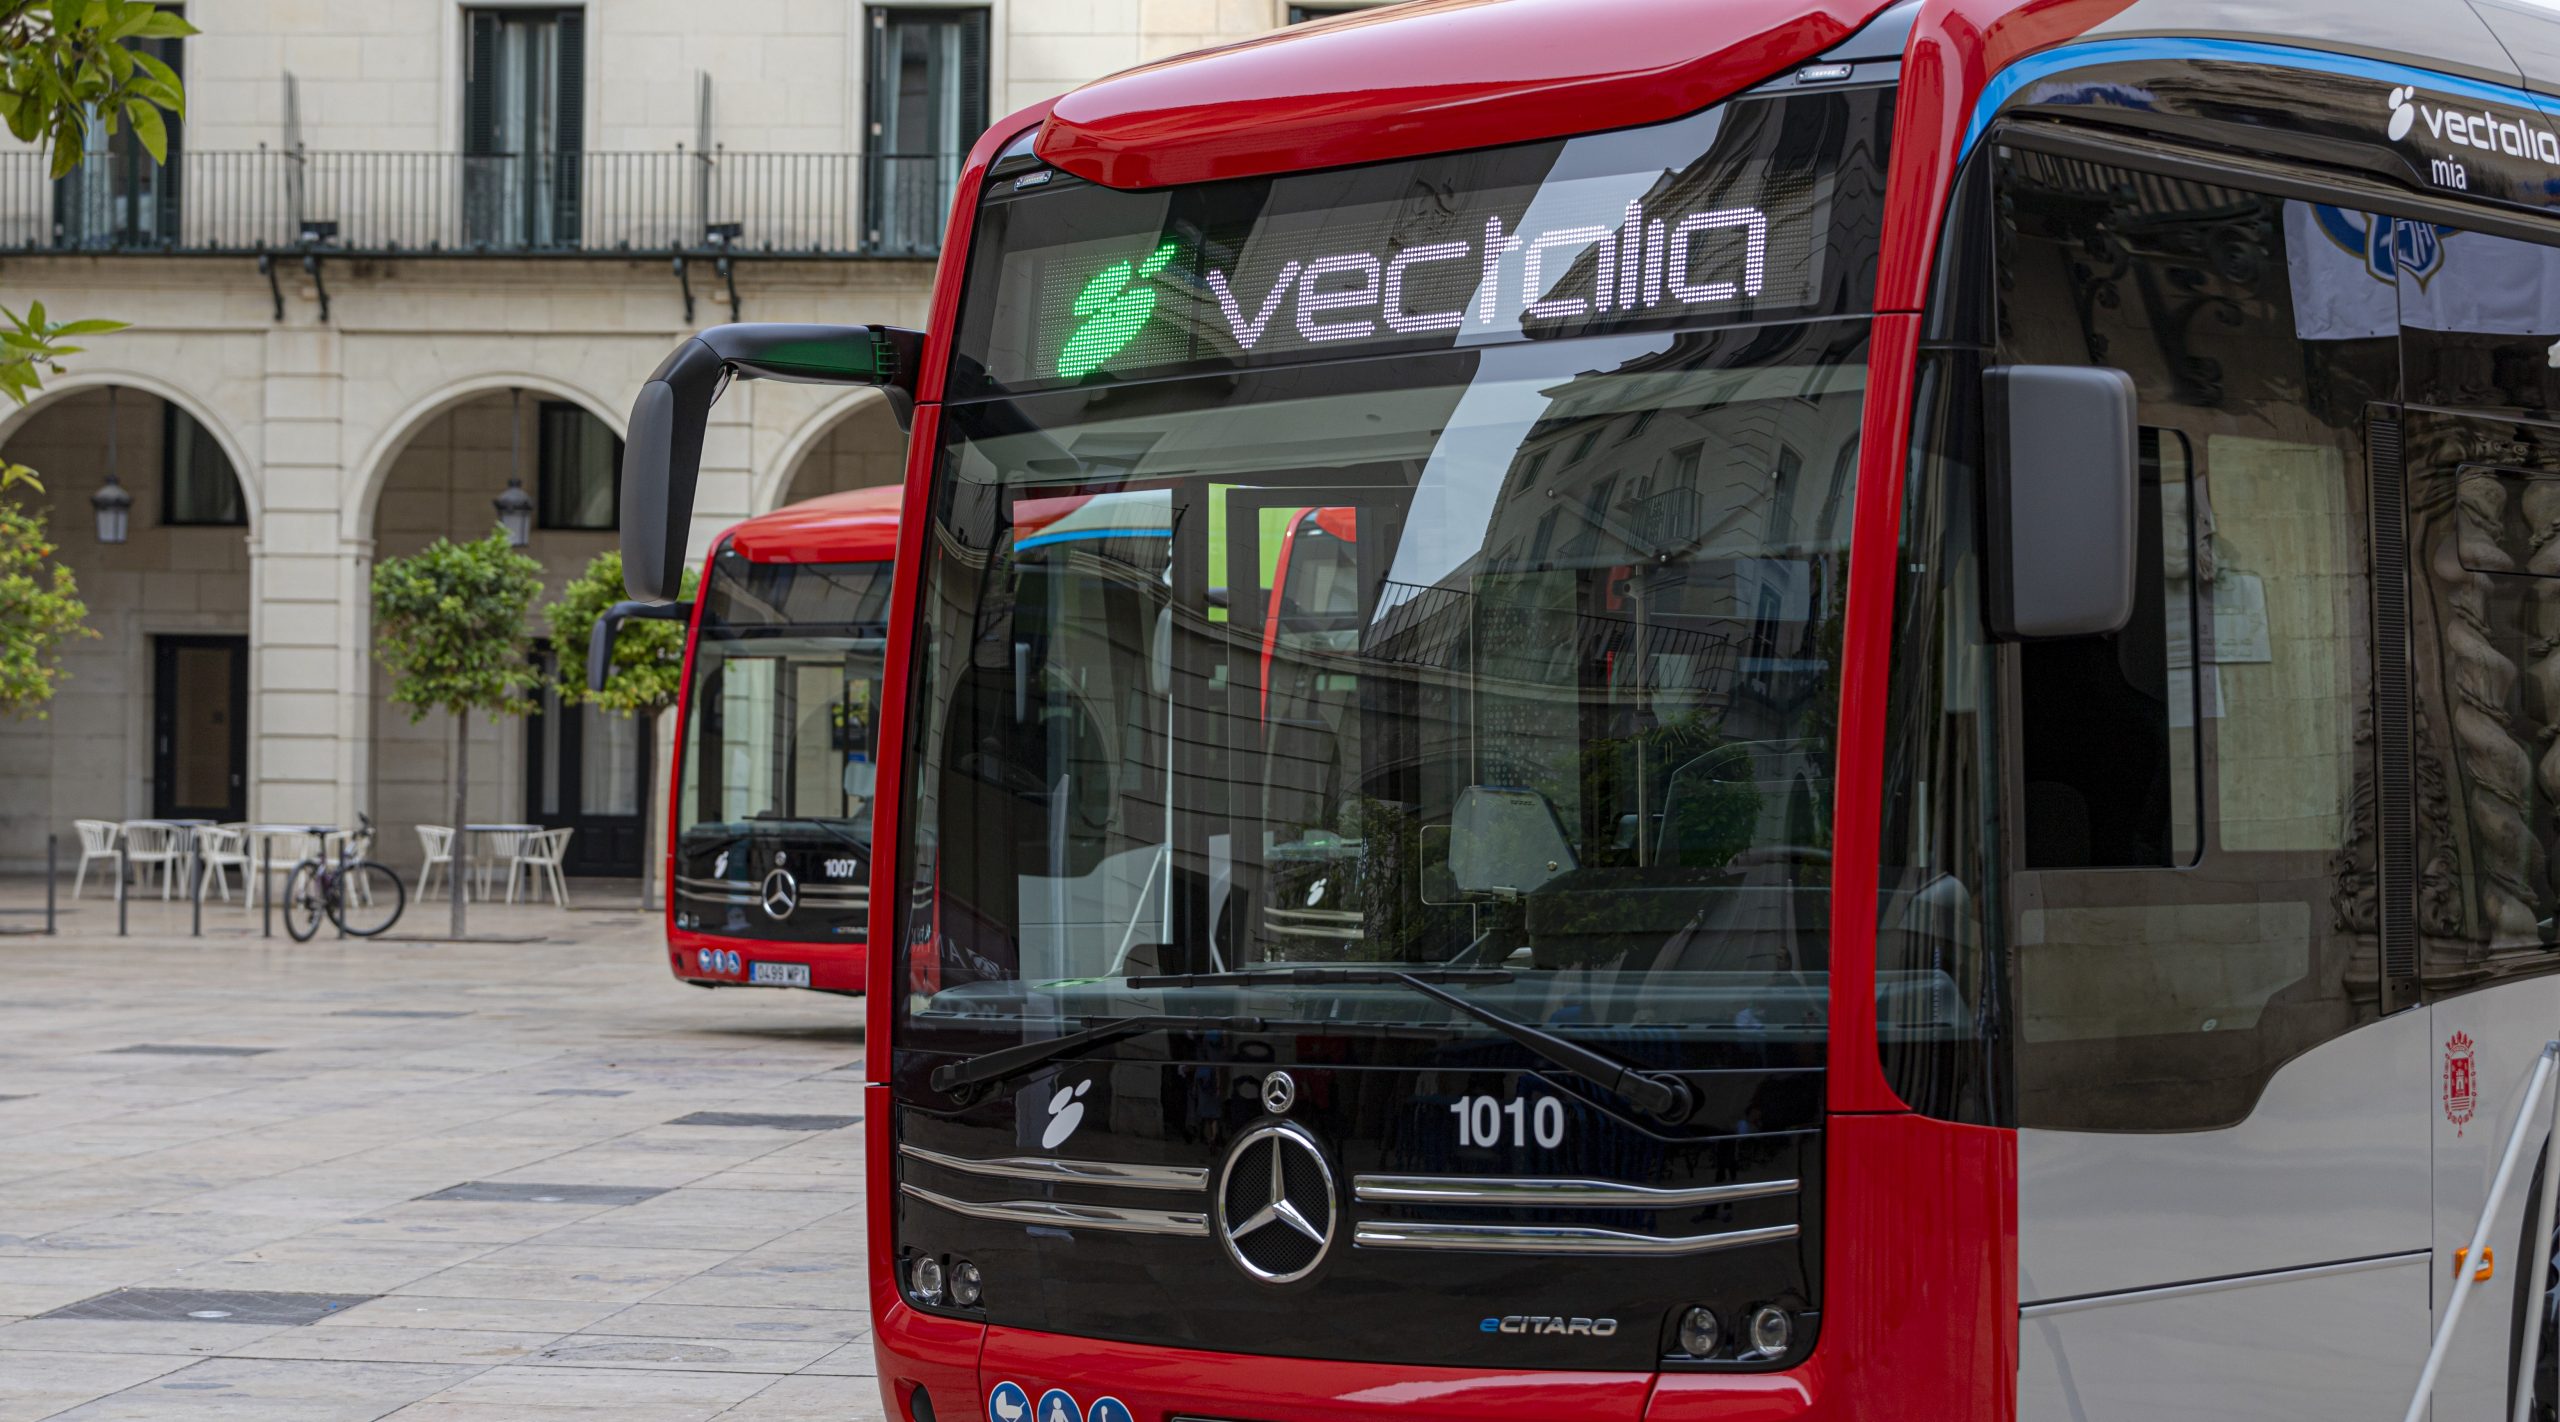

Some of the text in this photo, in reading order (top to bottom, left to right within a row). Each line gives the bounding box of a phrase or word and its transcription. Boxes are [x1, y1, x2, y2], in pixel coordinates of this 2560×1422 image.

[2420, 104, 2560, 165] vectalia
[2431, 153, 2468, 190] mia
[1206, 199, 1767, 350] vectalia
[824, 859, 857, 878] 1007
[1450, 1095, 1564, 1149] 1010
[1479, 1314, 1618, 1337] eCITARO
